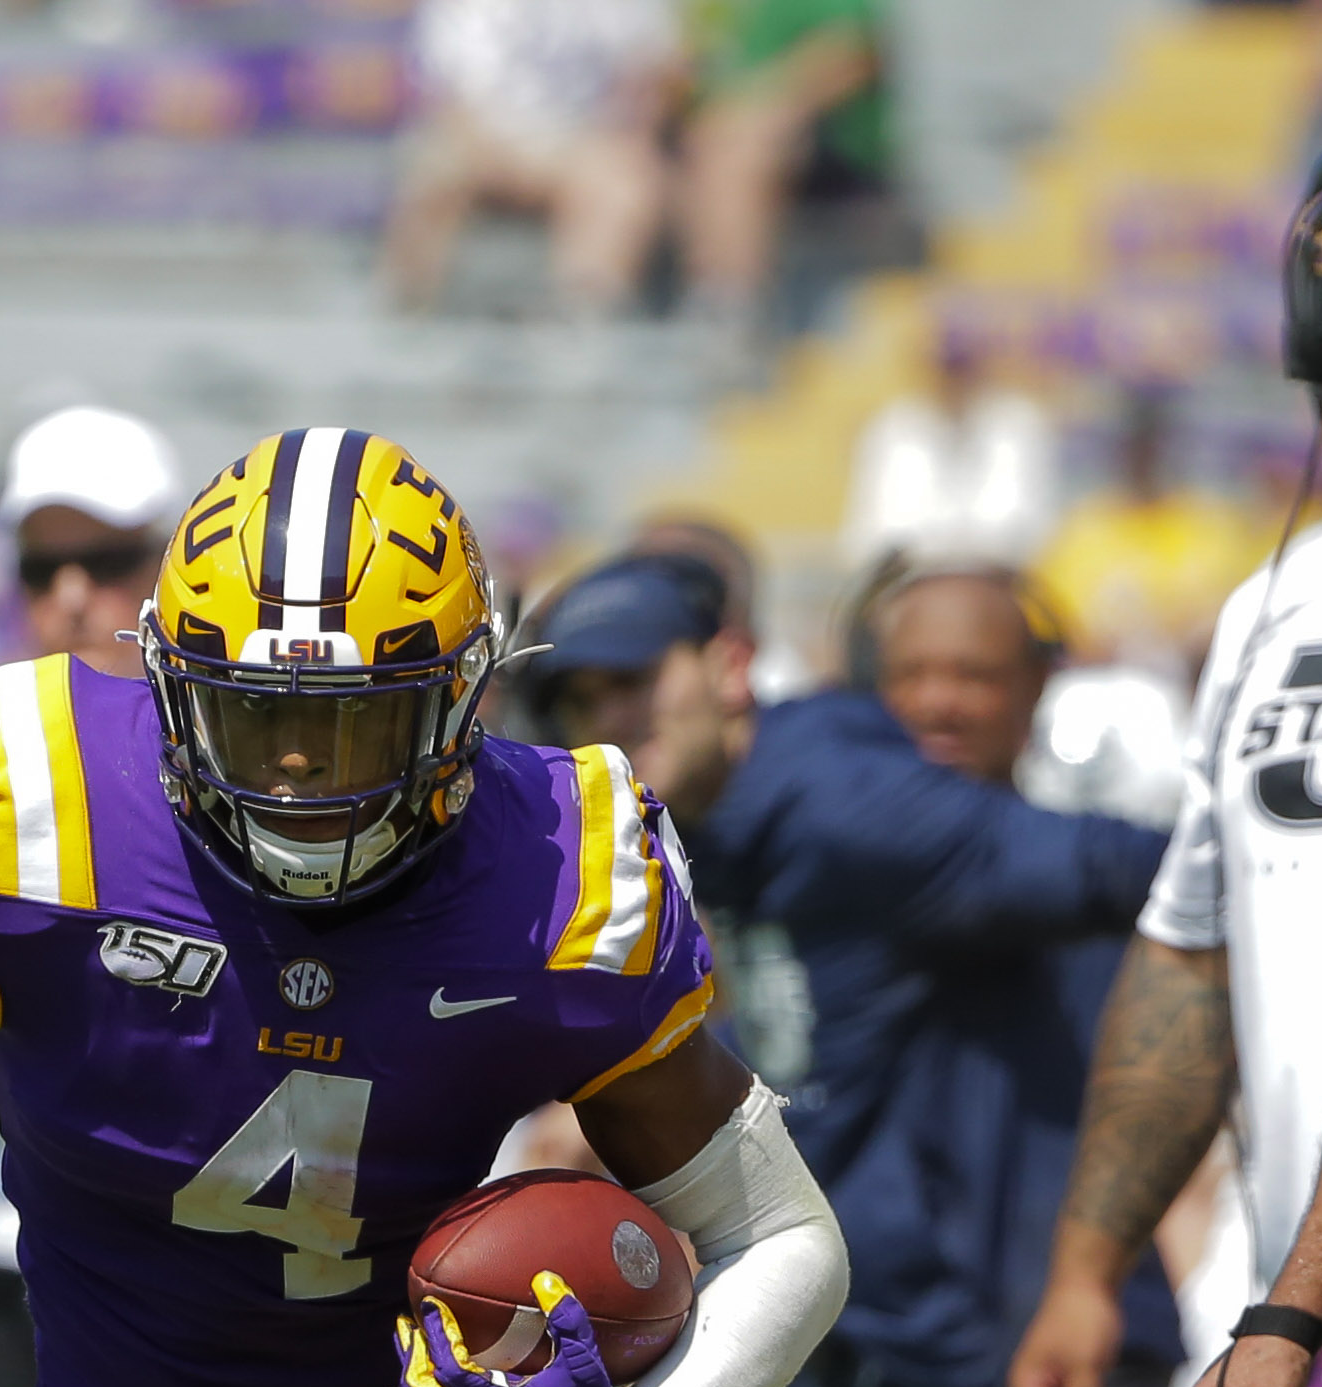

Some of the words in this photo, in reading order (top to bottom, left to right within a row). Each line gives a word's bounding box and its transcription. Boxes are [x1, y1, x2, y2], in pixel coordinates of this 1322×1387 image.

[269, 638, 334, 664] LSU
[281, 868, 330, 880] Riddell
[98, 922, 228, 997] 150
[283, 961, 330, 1007] SEC
[257, 1027, 343, 1062] LSU
[172, 1070, 372, 1299] 4
